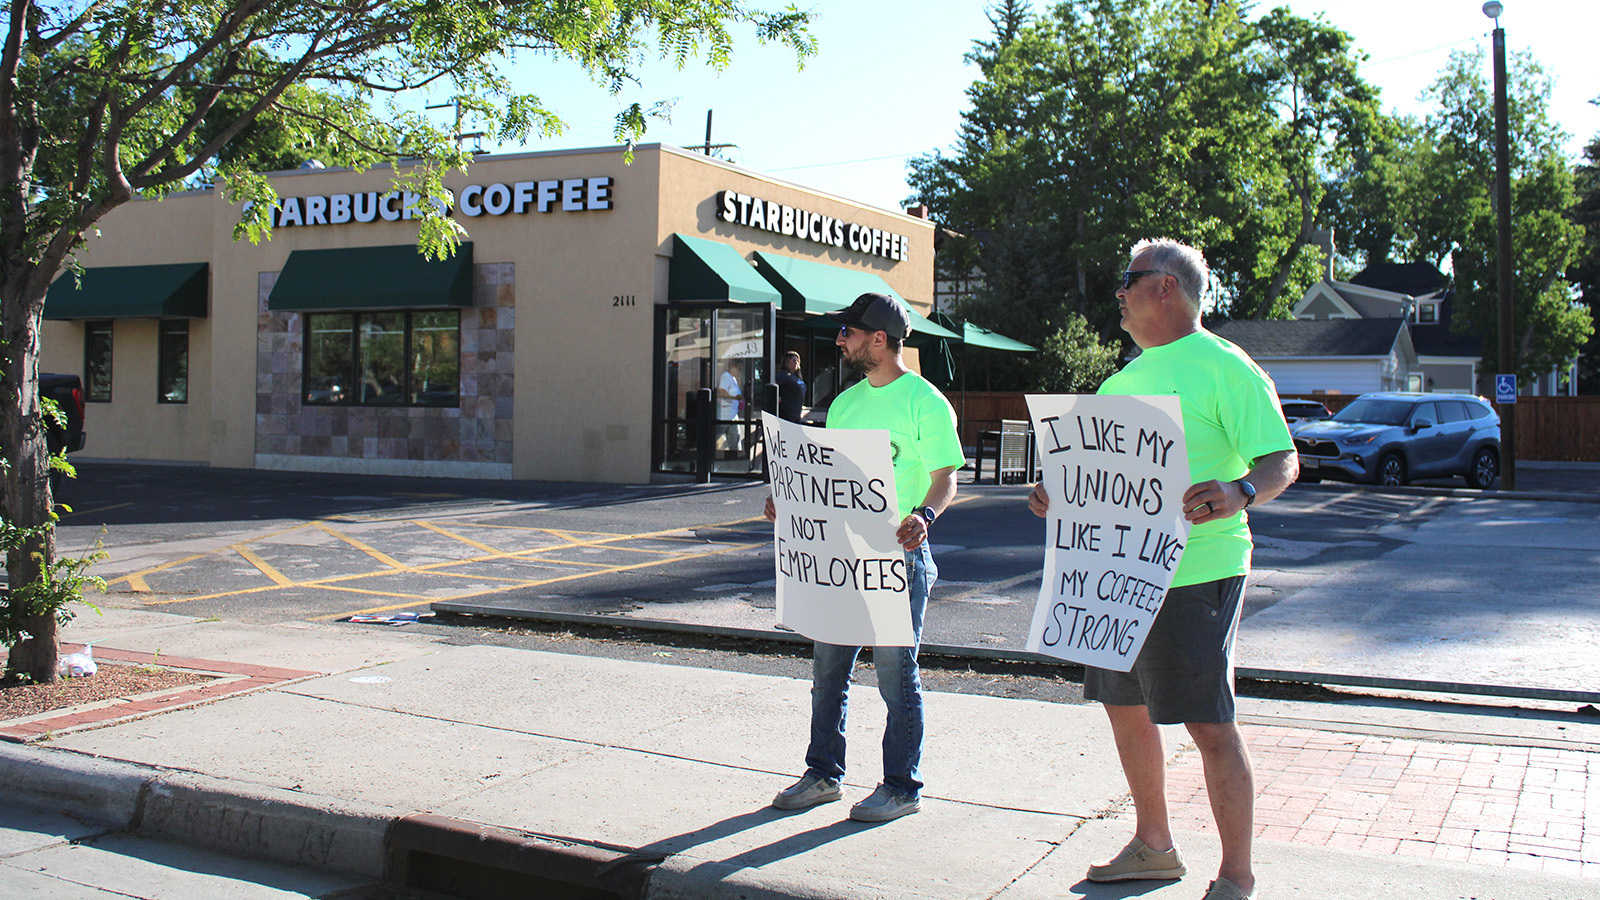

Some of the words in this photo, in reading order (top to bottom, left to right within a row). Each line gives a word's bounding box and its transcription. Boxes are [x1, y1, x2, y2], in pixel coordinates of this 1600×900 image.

[460, 177, 611, 217] COFFEE
[718, 189, 844, 248] STARBUCKS
[848, 222, 909, 262] COFFEE
[612, 295, 635, 307] 2111
[766, 426, 787, 459] WE
[796, 443, 835, 467] ARE
[1041, 416, 1071, 454] I
[1077, 415, 1126, 454] LIKE
[1136, 427, 1174, 468] MY
[770, 460, 888, 513] PARTNERS
[1062, 464, 1163, 516] UNIONS
[791, 514, 828, 541] NOT
[1055, 518, 1101, 552] LIKE
[1112, 524, 1131, 558] I
[1138, 528, 1184, 572] LIKE
[778, 537, 907, 593] EMPLOYEES
[1060, 569, 1089, 598] MY
[1042, 602, 1139, 657] STRONG
